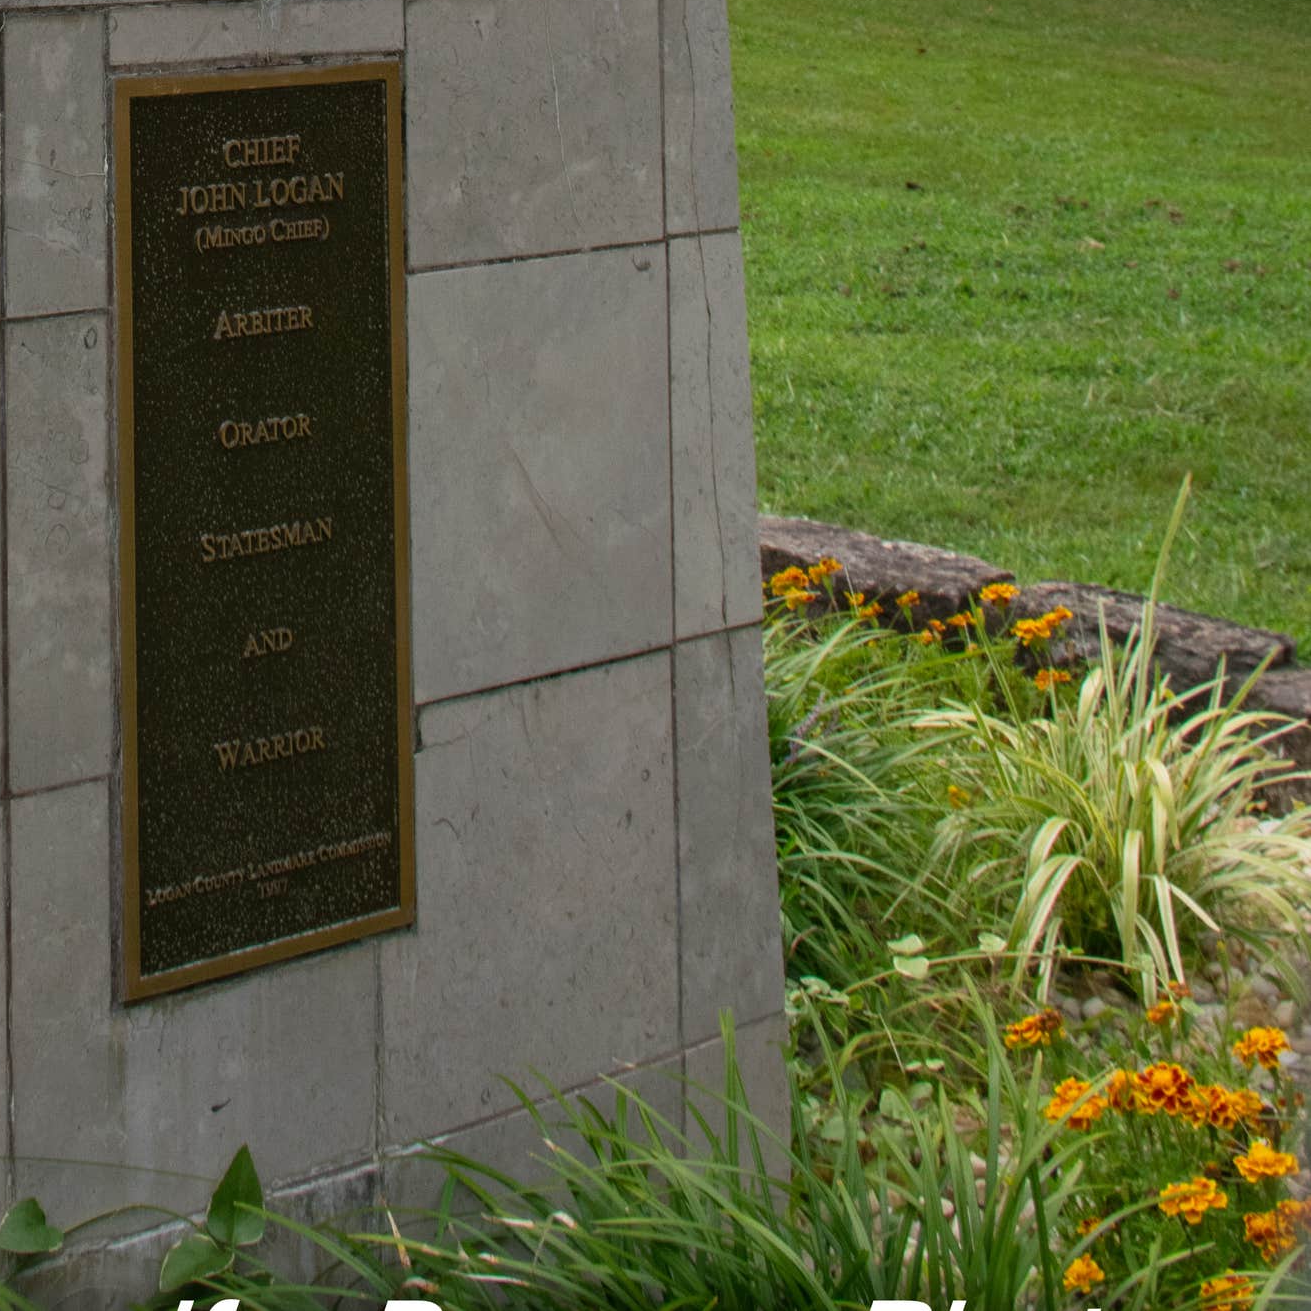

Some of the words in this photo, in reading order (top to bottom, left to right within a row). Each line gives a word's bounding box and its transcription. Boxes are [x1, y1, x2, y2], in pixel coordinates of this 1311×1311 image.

[224, 134, 301, 168] CHIEF
[176, 183, 246, 215] JOHN
[253, 172, 344, 207] LOGAN
[195, 225, 266, 254] (MINGO
[270, 215, 329, 241] CHIEF)
[213, 305, 313, 339] ARBITER
[219, 413, 313, 449] ORATOR
[200, 517, 332, 562] STATESMAN
[243, 627, 294, 657] AND
[214, 726, 326, 770] WARRIOR
